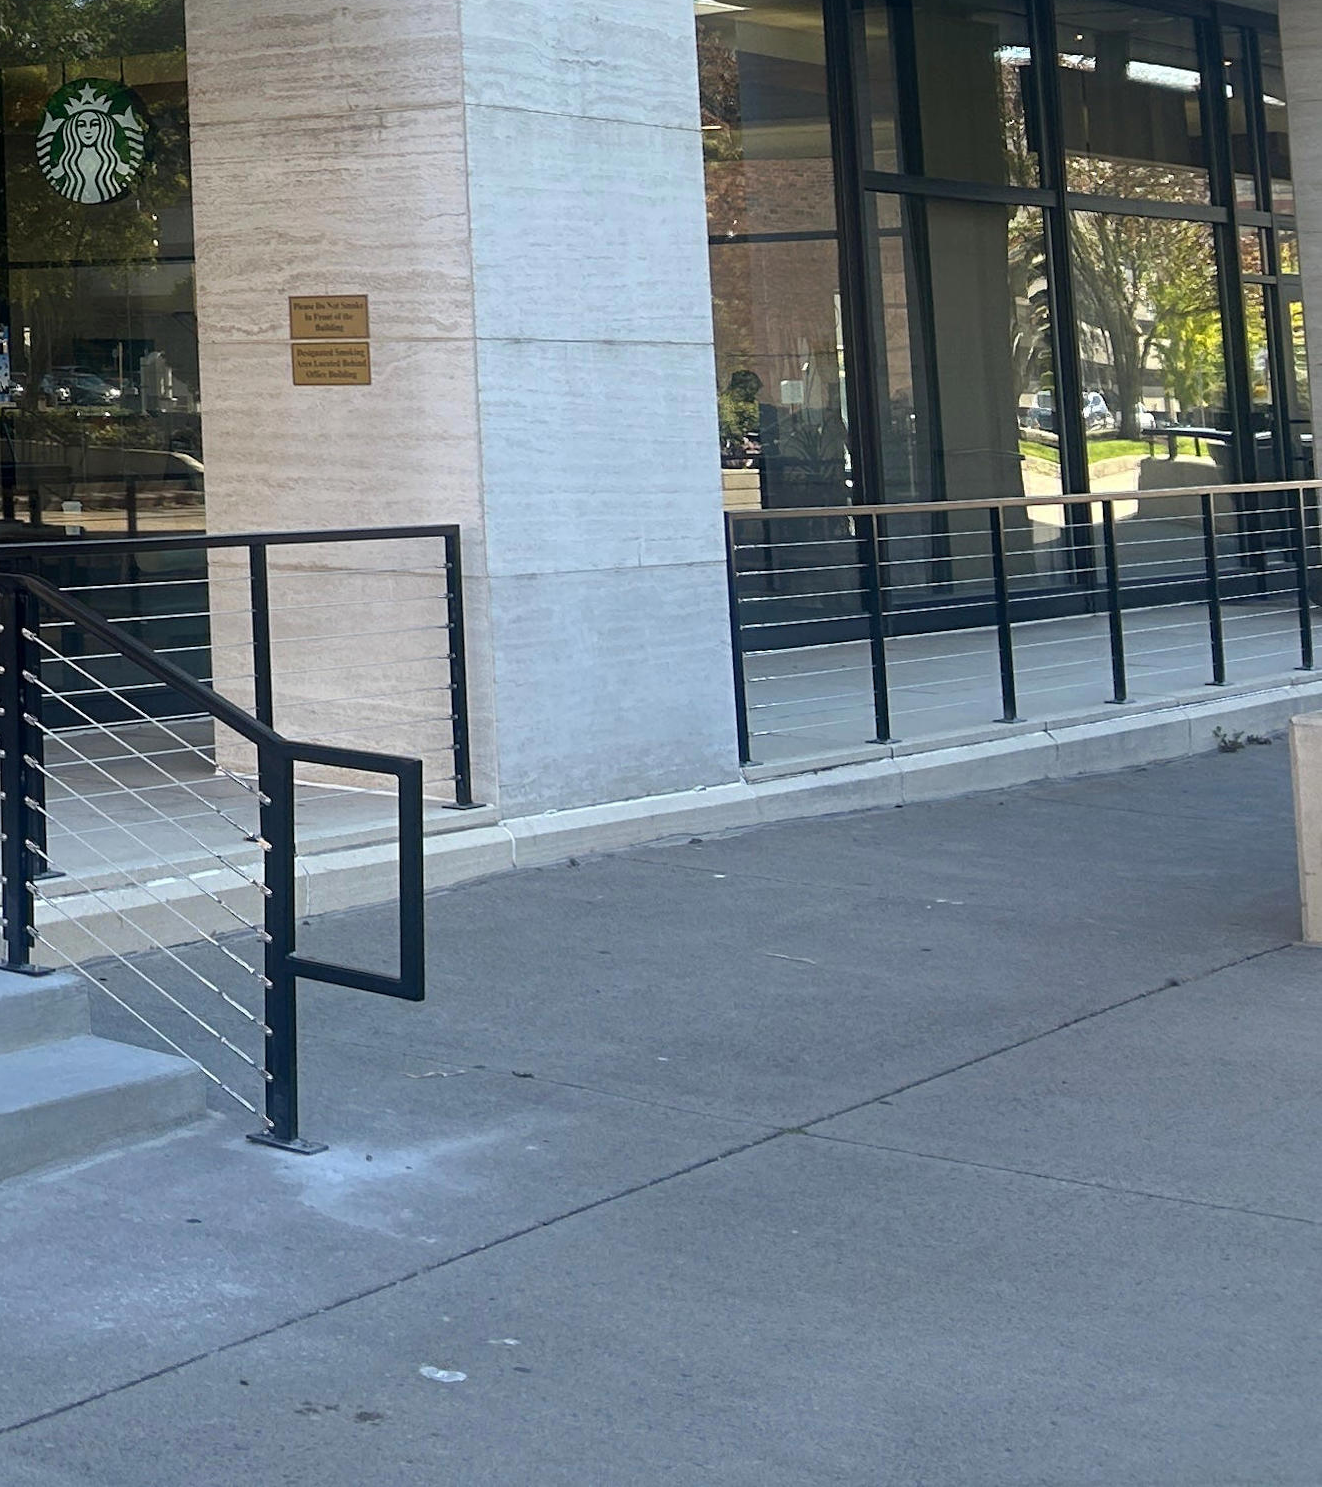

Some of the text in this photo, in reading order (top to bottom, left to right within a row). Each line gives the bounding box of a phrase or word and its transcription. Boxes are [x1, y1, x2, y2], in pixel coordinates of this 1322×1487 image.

[293, 301, 363, 310] Please Do Not Smoke
